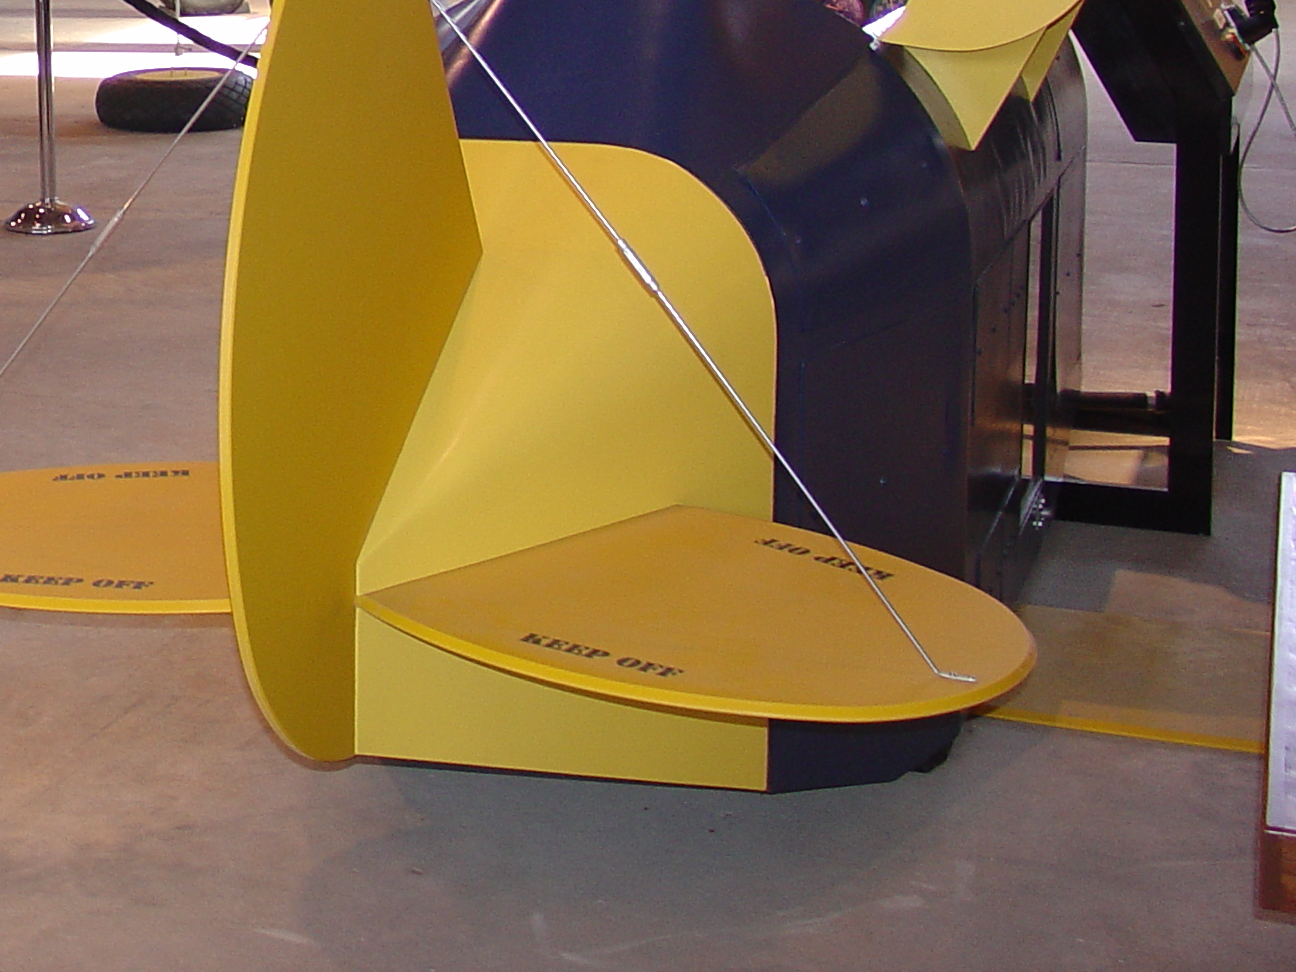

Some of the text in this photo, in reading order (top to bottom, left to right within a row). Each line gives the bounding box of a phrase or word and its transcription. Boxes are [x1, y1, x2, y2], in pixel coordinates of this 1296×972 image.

[52, 469, 190, 481] KEEP OFF
[754, 538, 811, 556] OFF
[0, 573, 154, 590] KEEP OFF
[519, 632, 684, 678] KEEP OFF
